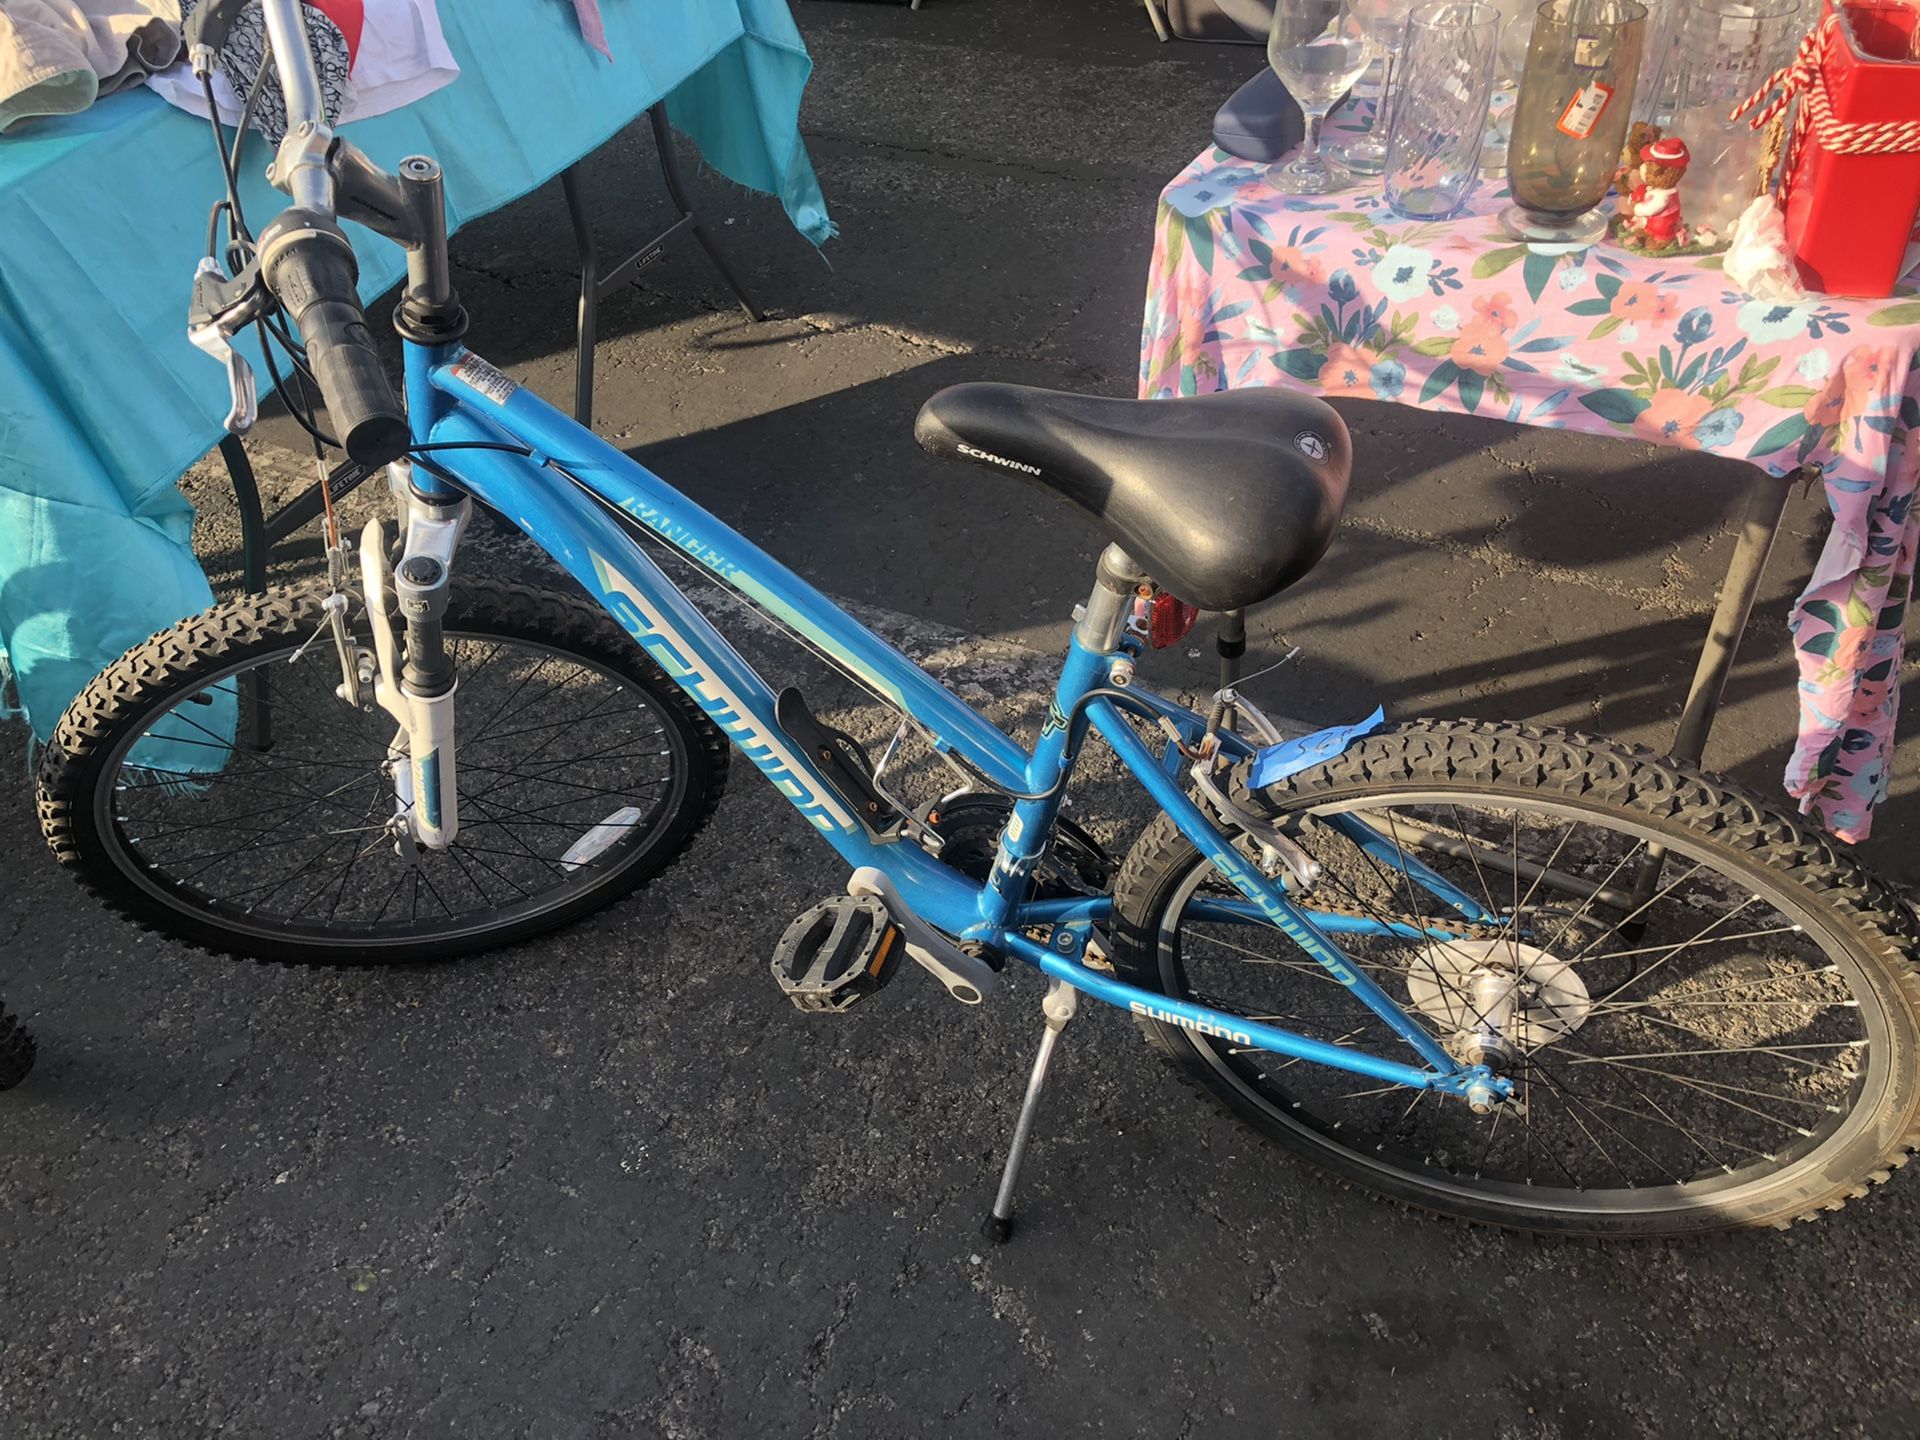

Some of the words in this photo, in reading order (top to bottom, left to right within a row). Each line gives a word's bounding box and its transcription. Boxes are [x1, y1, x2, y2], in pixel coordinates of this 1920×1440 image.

[956, 443, 1042, 476] SCHWINN
[625, 499, 739, 580] RANGER
[604, 590, 848, 838] SCHWINN
[1212, 853, 1357, 986] SCHWINN
